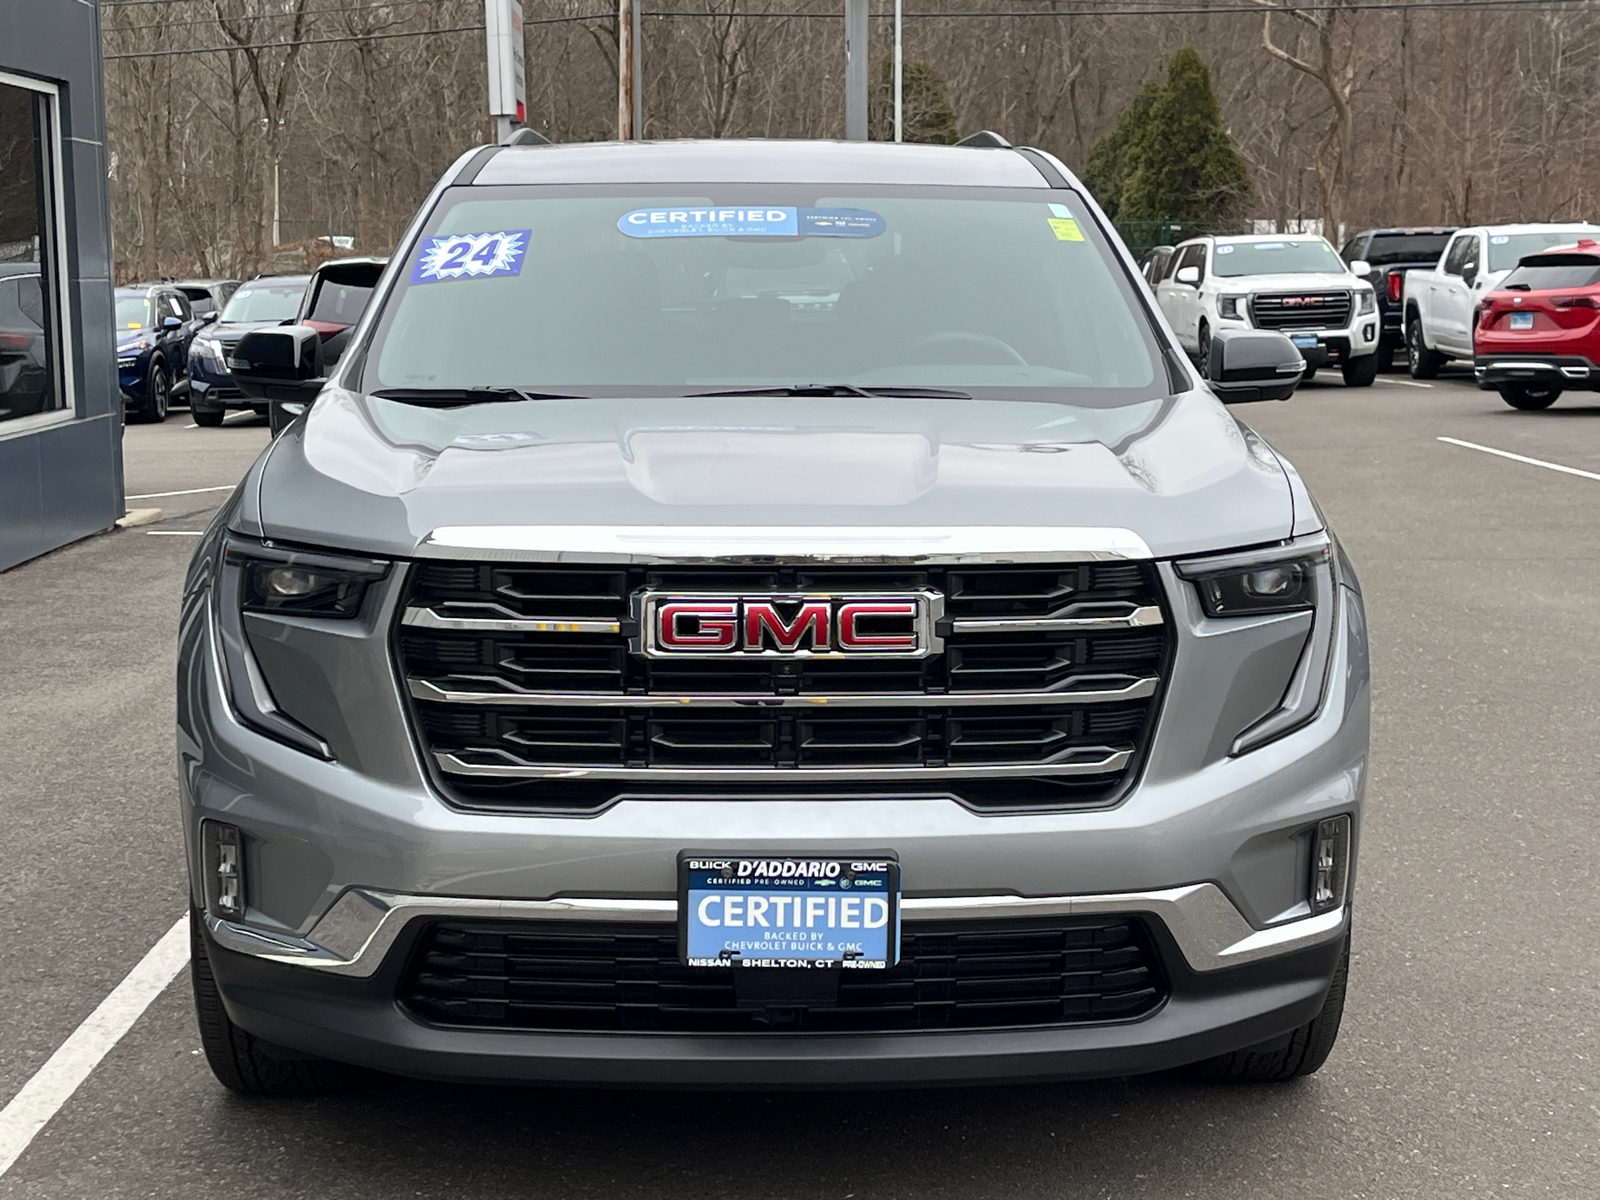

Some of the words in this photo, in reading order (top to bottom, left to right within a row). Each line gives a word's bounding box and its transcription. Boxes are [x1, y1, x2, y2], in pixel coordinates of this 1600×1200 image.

[628, 210, 787, 224] CERTIFIED
[439, 239, 502, 270] 24
[1282, 297, 1324, 308] GMC
[657, 602, 917, 652] GMC
[689, 860, 732, 870] BUICK
[737, 860, 841, 878] D'ADDARIO
[850, 862, 888, 872] GMC
[706, 877, 752, 885] CERTIFIED
[854, 879, 883, 887] GMC
[697, 894, 889, 929] CERTIFIED
[763, 931, 807, 941] BACKED
[810, 931, 824, 941] BY
[724, 940, 788, 951] CHEVROLET
[790, 941, 824, 951] BUICK
[826, 942, 835, 951] &
[837, 942, 864, 952] GMC
[687, 958, 732, 968] NISSAN
[742, 958, 812, 969] SHELTON,
[814, 959, 835, 968] CT
